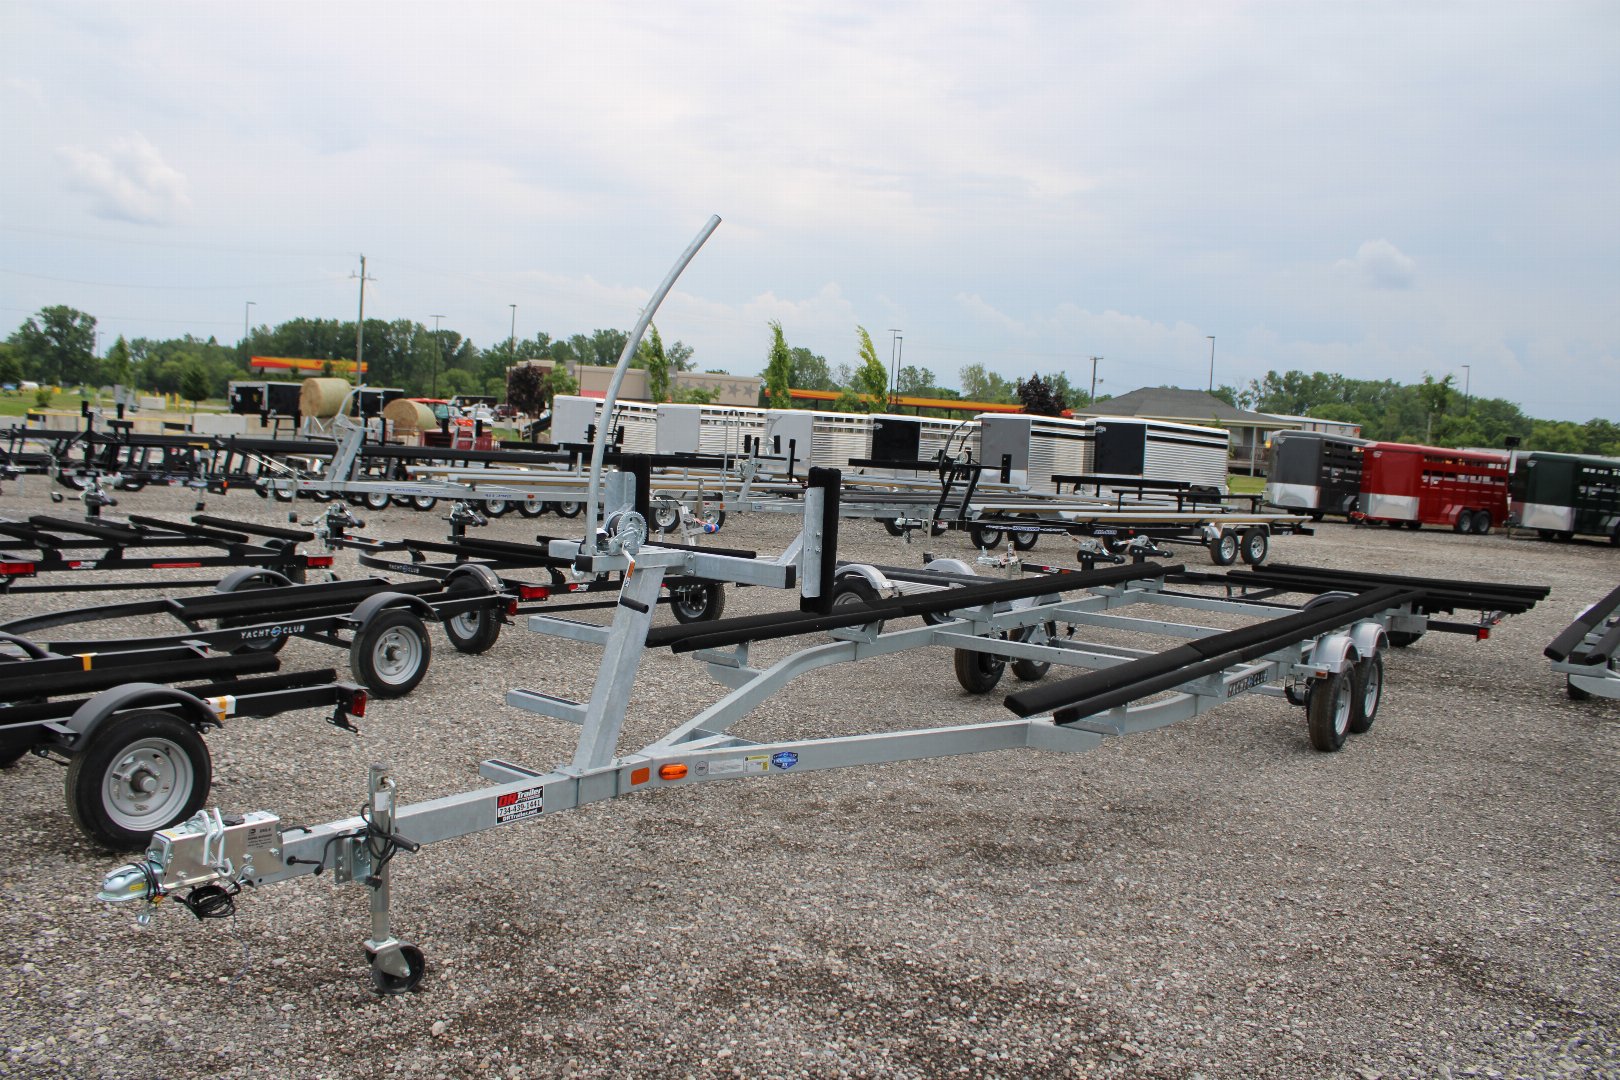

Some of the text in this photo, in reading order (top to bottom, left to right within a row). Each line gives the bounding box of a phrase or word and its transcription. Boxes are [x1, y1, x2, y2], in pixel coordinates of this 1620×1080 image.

[241, 625, 305, 639] YACHT CLUB
[498, 793, 518, 807] DR
[517, 788, 543, 799] Trailer
[499, 799, 541, 816] 734-439-1441
